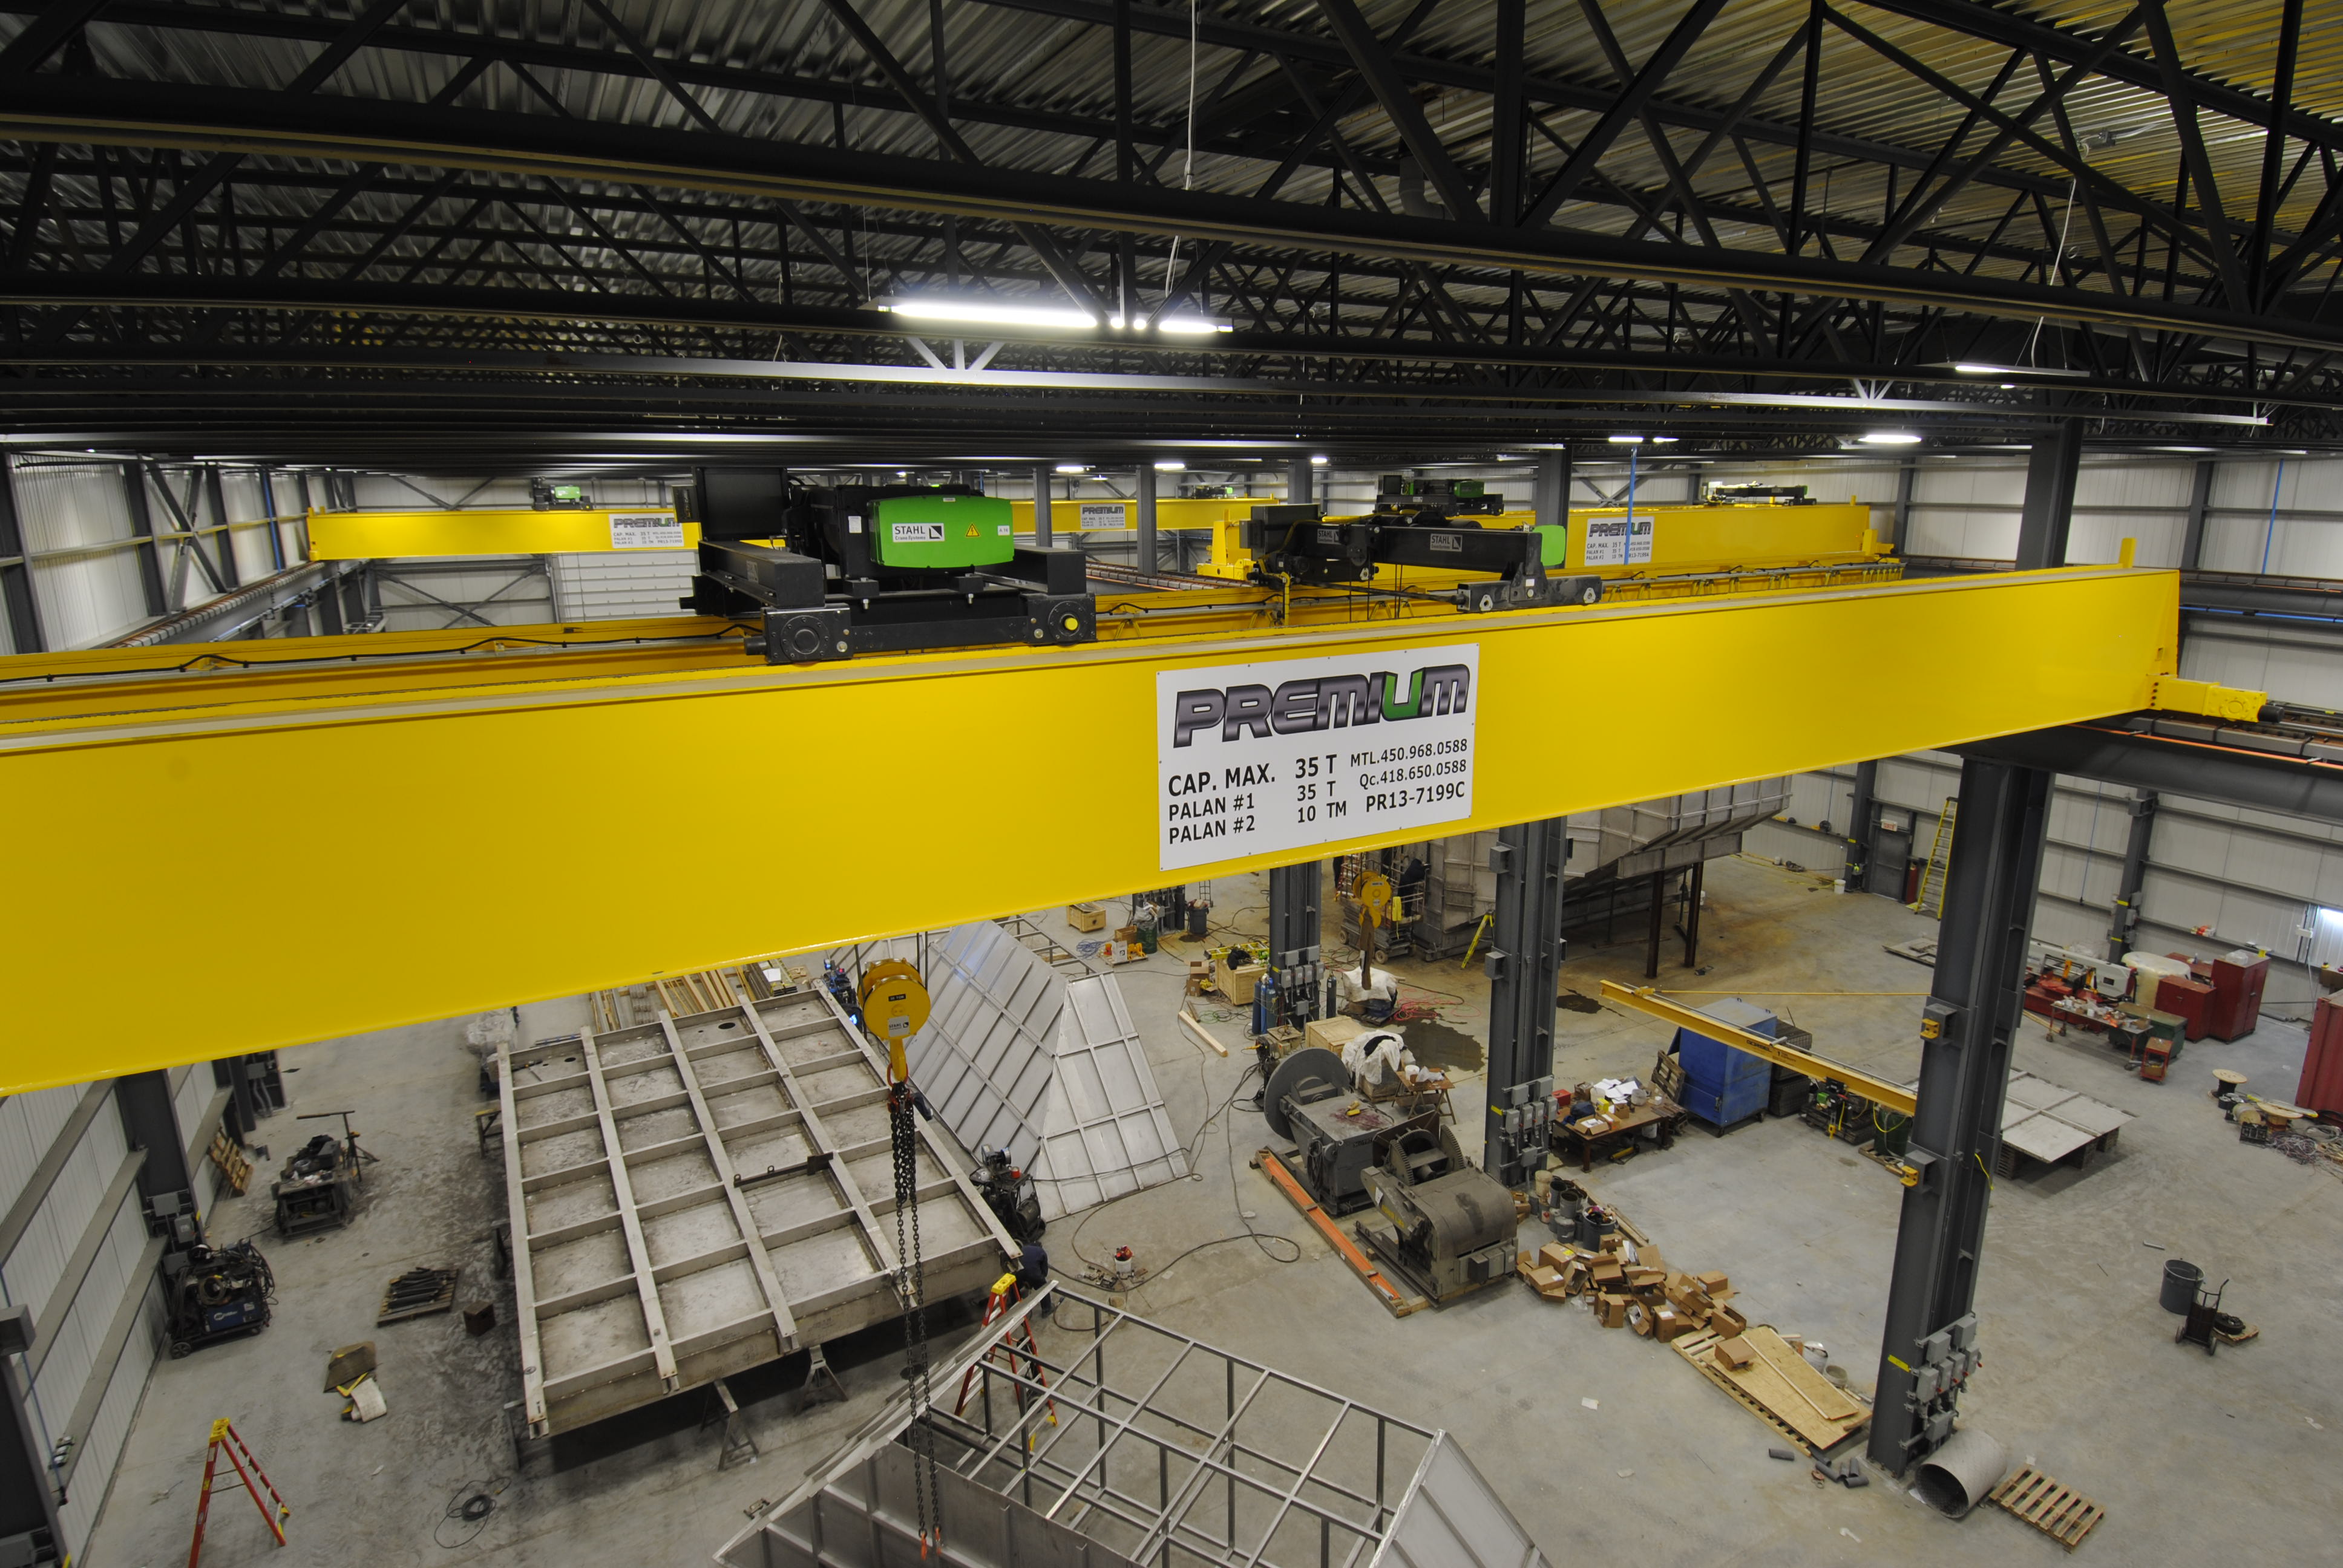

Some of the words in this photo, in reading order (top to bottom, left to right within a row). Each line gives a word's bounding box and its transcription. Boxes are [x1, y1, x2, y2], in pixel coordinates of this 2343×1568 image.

[614, 517, 680, 528] PREMIUM
[894, 526, 926, 535] STAHL
[1589, 522, 1651, 537] PREMUM
[1432, 535, 1450, 544] STAHL
[1173, 664, 1470, 748] PREMIUM
[1351, 739, 1467, 767] MTL.450.968.0588
[1168, 772, 1216, 797] CAP.
[1226, 763, 1275, 789] MAX.
[1296, 757, 1319, 779] 35
[1326, 754, 1337, 774] T
[1360, 760, 1466, 789] Qc.418.650.0588
[1169, 797, 1226, 821] PALAN
[1233, 793, 1254, 811] #1
[1297, 784, 1316, 801] 35
[1327, 781, 1336, 796] T
[1366, 782, 1465, 812] PR13-7199C
[1169, 820, 1226, 844] PALAN
[1233, 815, 1255, 833] #2
[1298, 806, 1316, 823] 10
[1326, 801, 1346, 818] TM
